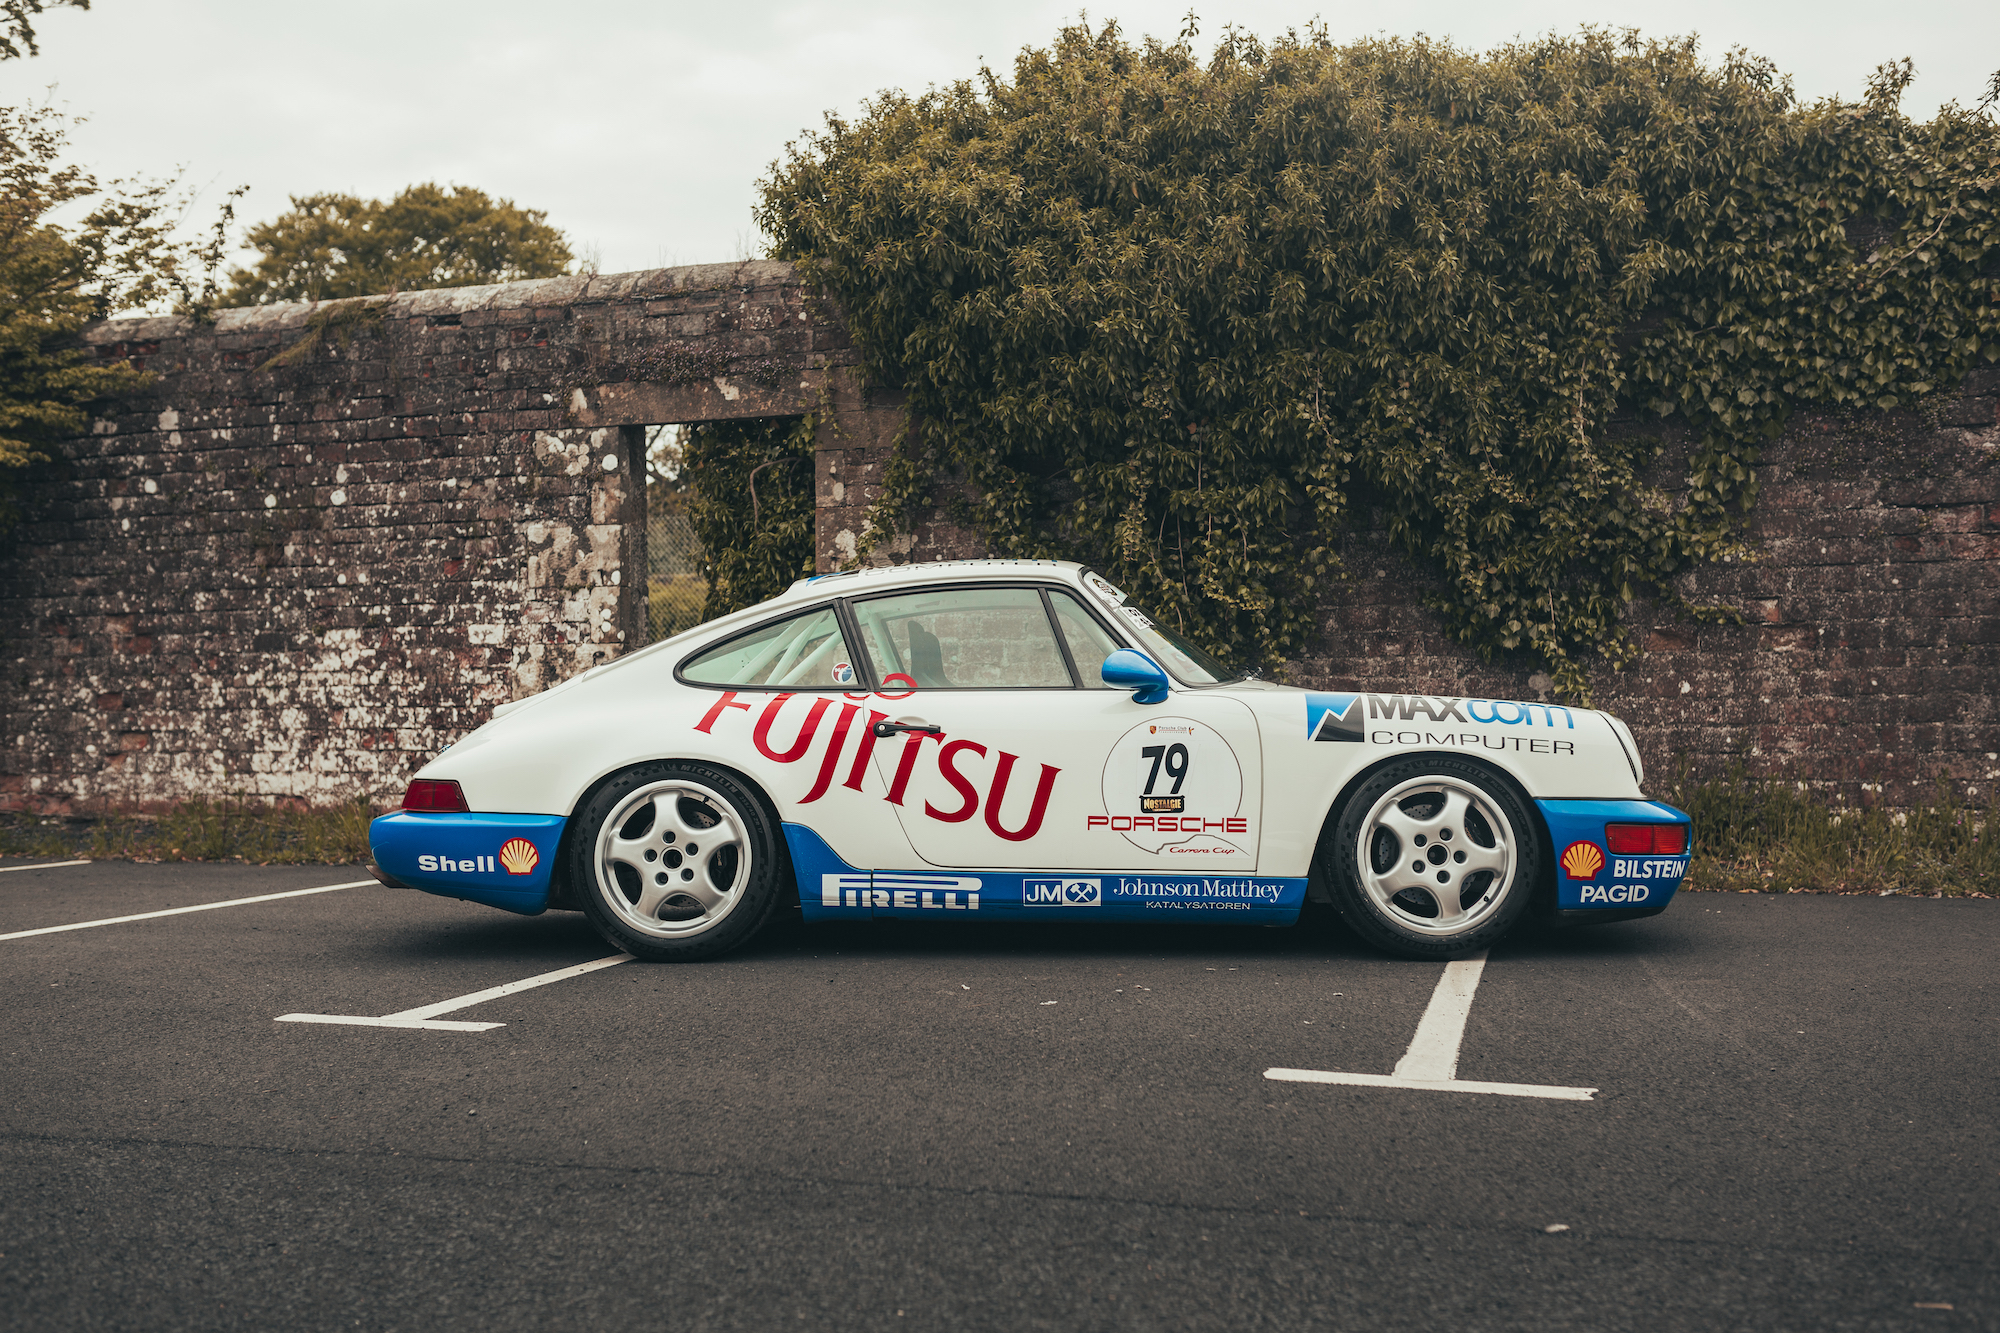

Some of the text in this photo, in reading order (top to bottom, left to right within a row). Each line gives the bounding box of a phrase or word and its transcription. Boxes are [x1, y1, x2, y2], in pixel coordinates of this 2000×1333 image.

[1366, 693, 1575, 730] MAXcom
[1371, 730, 1575, 756] COMPUTER
[693, 691, 1062, 842] FUJITSU
[1142, 742, 1189, 795] 79
[681, 764, 738, 793] MICHELIN
[1428, 760, 1487, 779] MICHELIN
[1489, 779, 1505, 794] PILOT
[1504, 793, 1520, 812] SPORT
[1143, 798, 1182, 810] NOSTALGIE
[1087, 815, 1248, 833] PORSCHE
[1169, 846, 1235, 855] Carrera Cup
[417, 854, 496, 873] Shell
[1613, 859, 1686, 879] BILSTEIN
[821, 873, 983, 910] PIRELLI
[1026, 884, 1062, 903] JM
[1113, 878, 1285, 903] Johnson Matthey
[1580, 884, 1650, 903] PAGID
[1145, 900, 1251, 910] KATALYSATOREN
